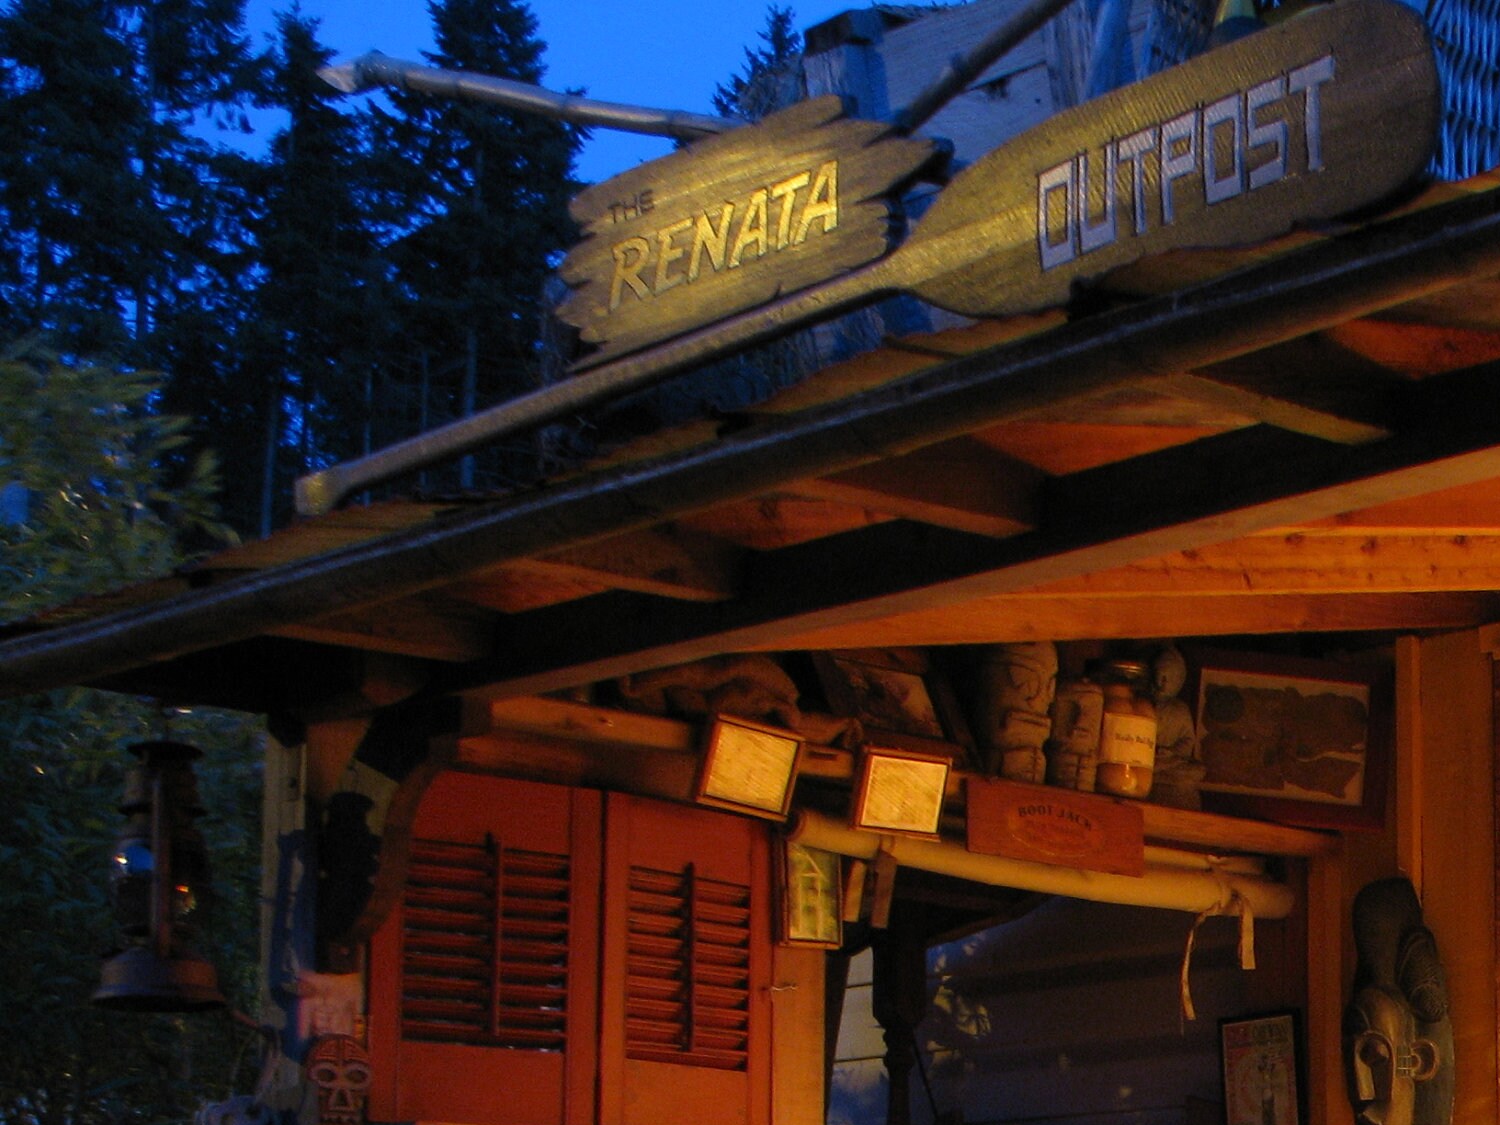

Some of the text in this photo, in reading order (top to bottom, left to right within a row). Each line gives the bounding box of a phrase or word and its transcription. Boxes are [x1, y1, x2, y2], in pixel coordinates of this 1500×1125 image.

[608, 189, 655, 224] THE
[608, 160, 840, 314] RENATA
[1037, 53, 1337, 273] OUTPOST
